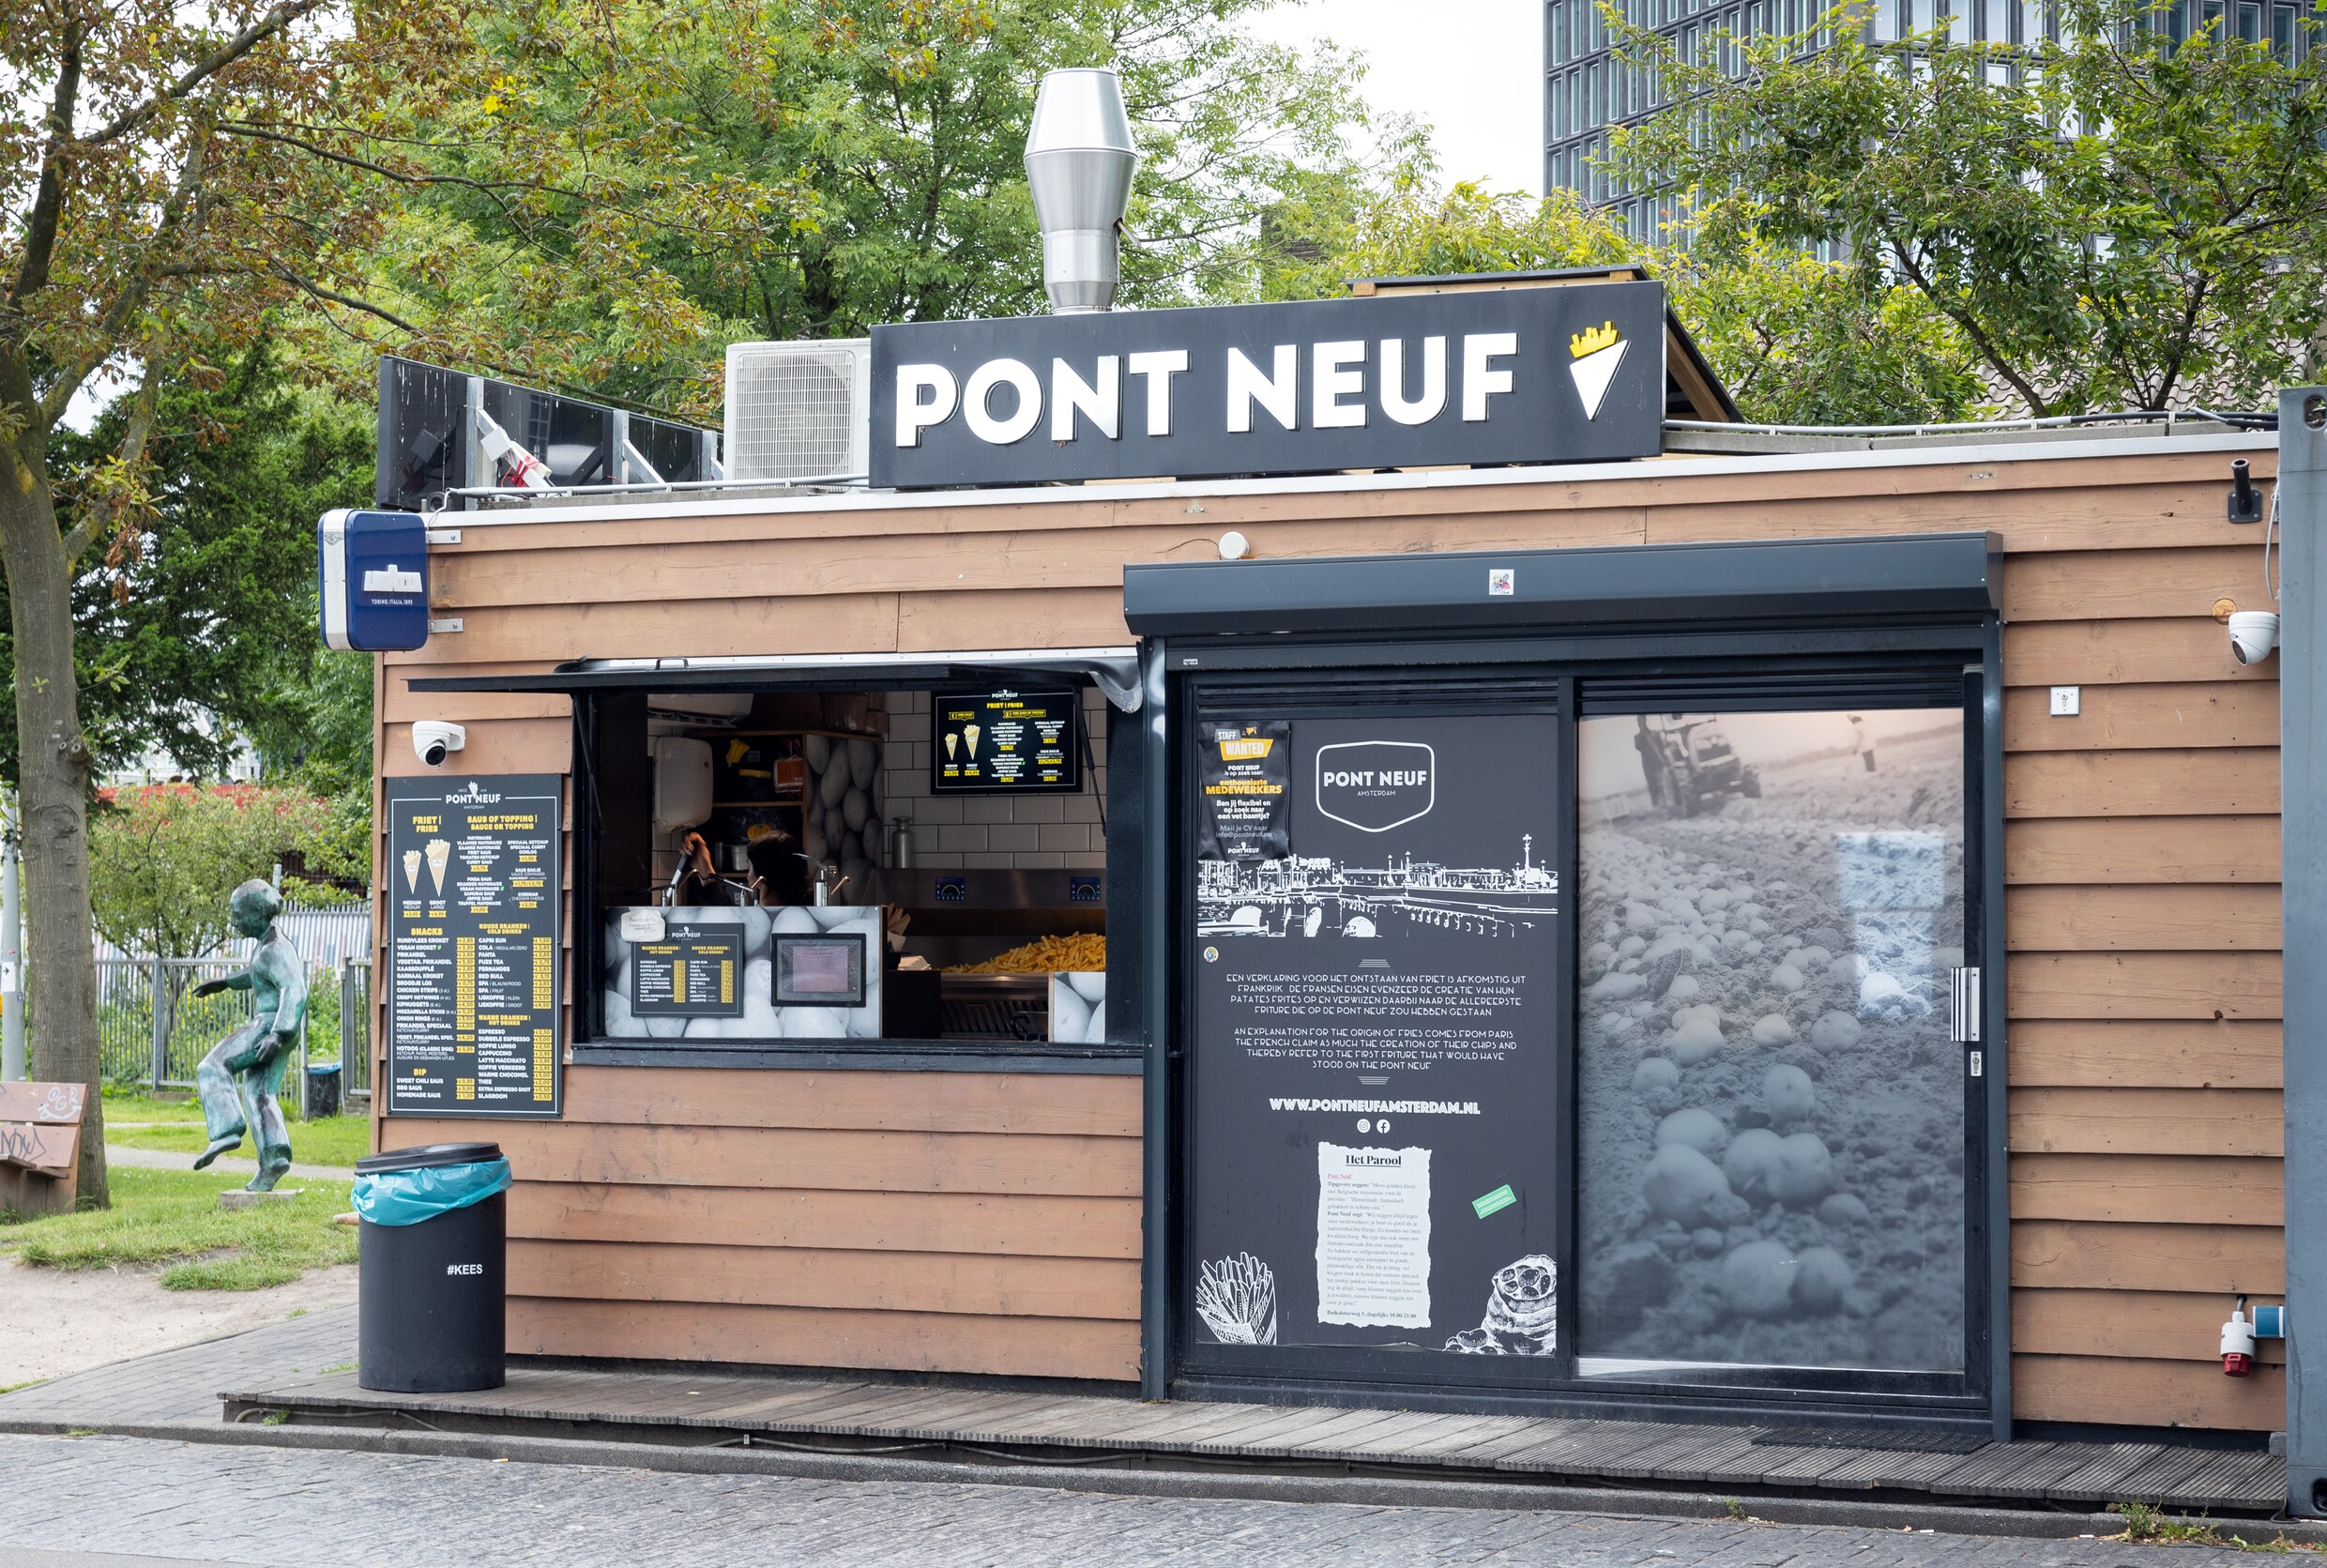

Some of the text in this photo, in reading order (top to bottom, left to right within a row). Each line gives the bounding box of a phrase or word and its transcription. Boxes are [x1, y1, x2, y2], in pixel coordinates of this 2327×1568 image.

[896, 331, 1519, 447] PONT NEUF
[1218, 731, 1236, 740] STAFF
[1225, 742, 1264, 755] WANTED
[1324, 771, 1427, 787] PONT NEUF
[1206, 785, 1282, 794] MEDEWERKERS
[446, 794, 501, 804] PONT NEUF
[1460, 997, 1521, 1005] ALLEREERSTE
[1269, 1098, 1480, 1114] WWW.PONTNEUFAMSTERDAM.NL
[1347, 1155, 1401, 1166] Het Parool
[447, 1264, 483, 1275] #KEES
